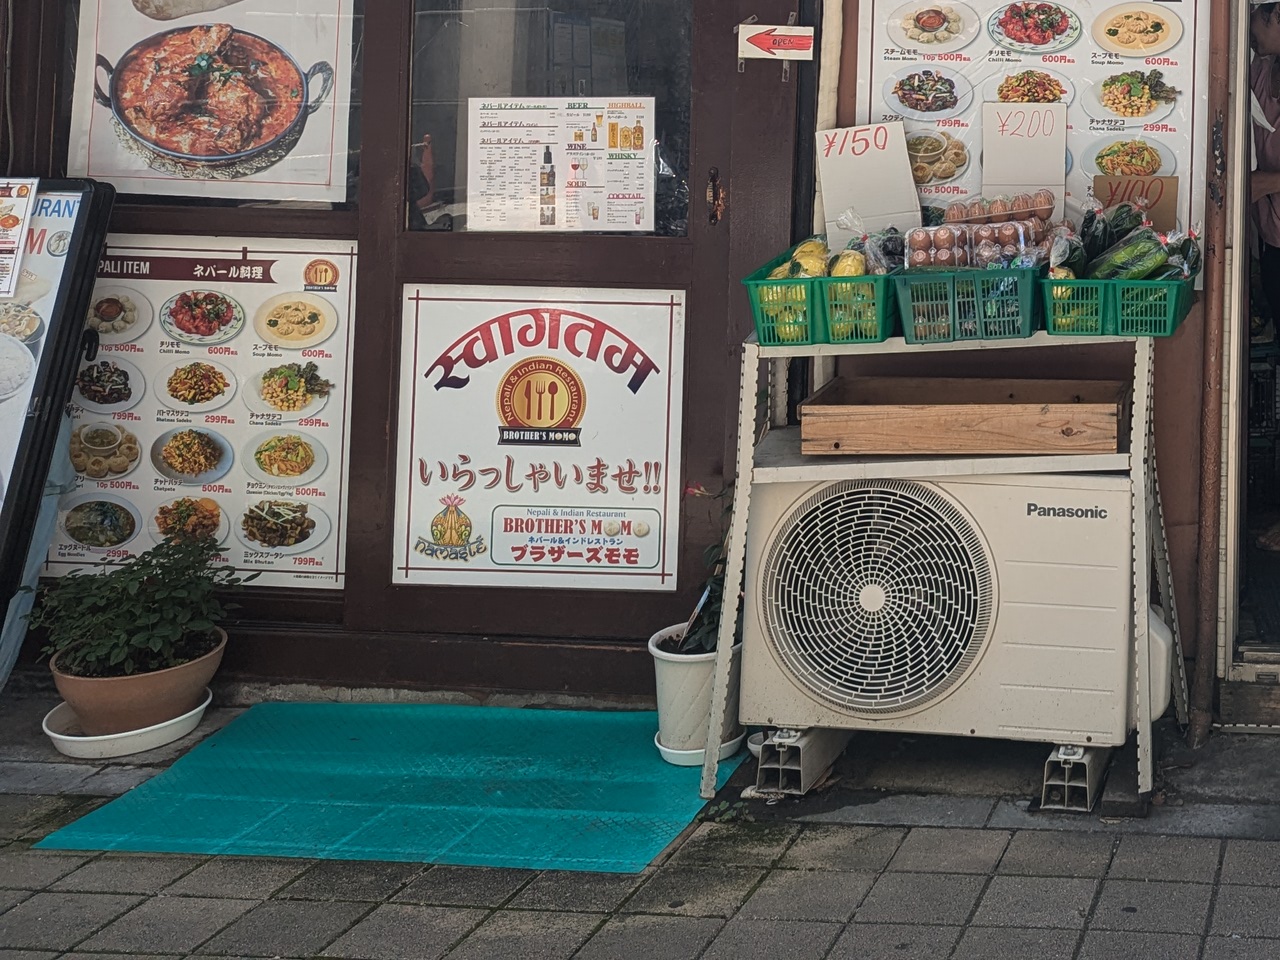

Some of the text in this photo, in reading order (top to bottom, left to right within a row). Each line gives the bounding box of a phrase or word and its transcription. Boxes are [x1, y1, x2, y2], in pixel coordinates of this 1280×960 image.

[988, 49, 1012, 57] チリモモ
[1091, 51, 1120, 59] スープモモ
[996, 110, 1055, 138] ¥200
[823, 125, 888, 158] ¥150
[123, 260, 150, 275] ITEM
[193, 265, 263, 280] ネパール料理
[159, 341, 181, 349] チリモモ
[253, 343, 279, 352] スープモモ
[503, 361, 578, 422] Nepali & Indian Restaurant
[503, 431, 547, 440] BROTHER'S
[527, 508, 551, 517] Nepali
[561, 509, 584, 517] Indian
[586, 510, 626, 518] Restaurant
[1026, 502, 1108, 520] Panasonic
[503, 517, 586, 535] BROTHER'S
[511, 544, 640, 565] ブラザーズモモ
